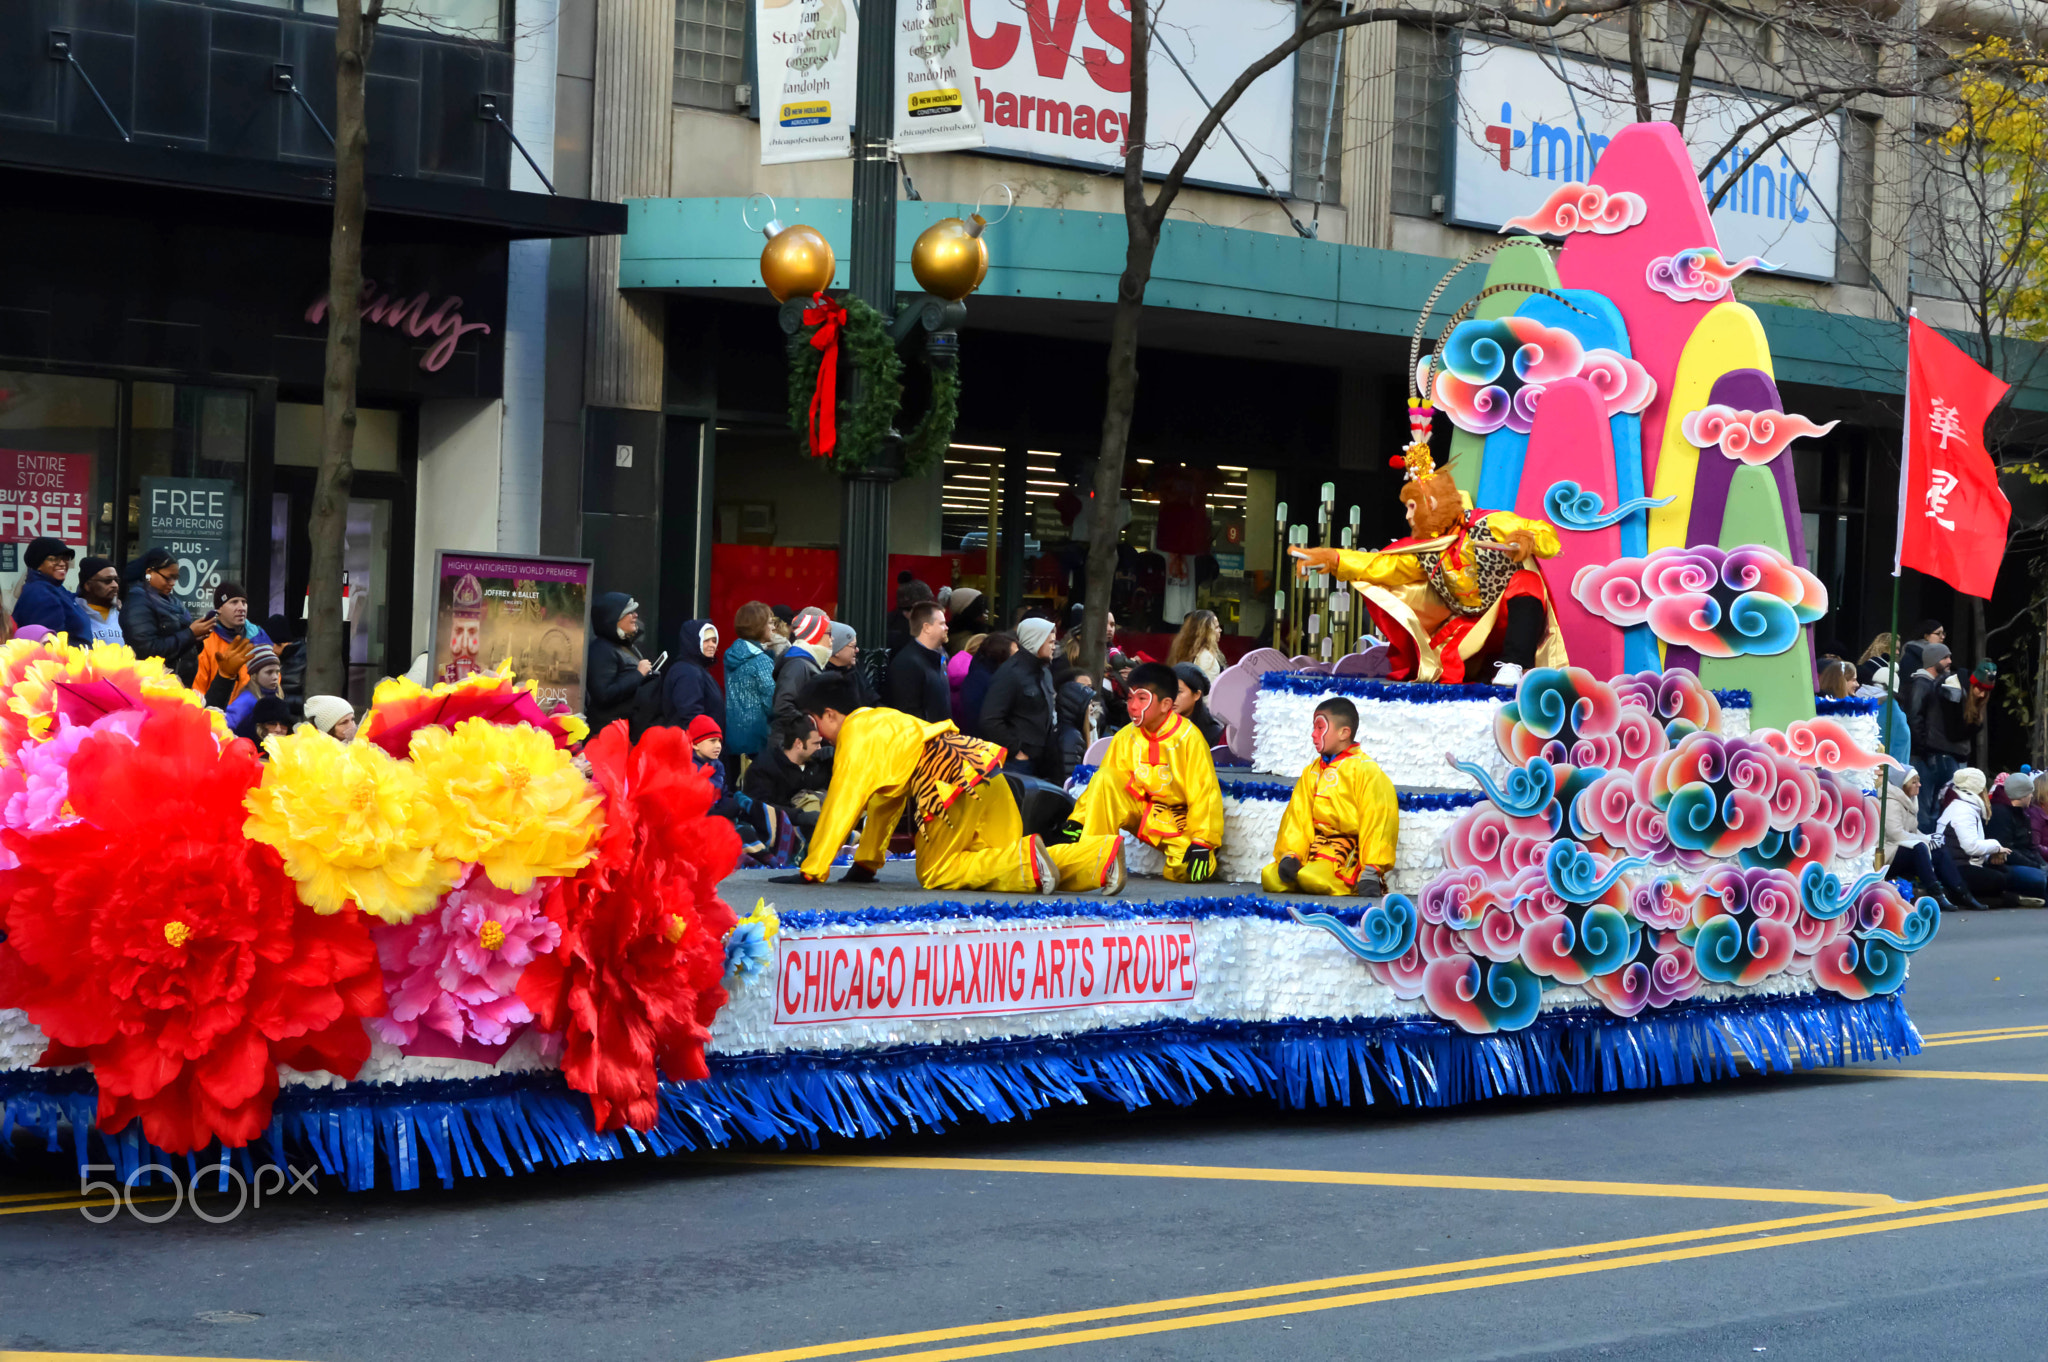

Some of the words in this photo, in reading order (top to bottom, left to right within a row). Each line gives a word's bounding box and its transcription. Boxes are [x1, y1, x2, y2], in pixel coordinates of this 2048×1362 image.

[800, 12, 820, 24] am
[929, 12, 956, 28] Street
[772, 30, 804, 45] Stae
[806, 25, 837, 41] Street
[964, 0, 1132, 93] CVS
[907, 66, 957, 83] Randolph
[784, 77, 831, 95] andolph
[918, 96, 931, 104] NEW
[932, 94, 958, 103] HOLLAND
[791, 108, 803, 116] NEW
[803, 106, 827, 114] HOLLAND
[974, 76, 1130, 157] harmacy
[1707, 146, 1810, 224] clinic
[17, 455, 67, 472] ENTIRE
[17, 472, 65, 488] STORE
[0, 489, 27, 503] BUY
[29, 491, 38, 504] 3
[42, 492, 70, 505] GET
[73, 493, 82, 506] 3
[152, 488, 224, 518] FREE
[0, 503, 83, 539] FREE
[151, 516, 173, 528] EAR
[175, 518, 224, 530] PIERCING
[1230, 527, 1237, 540] 9
[172, 542, 202, 554] PLUS
[171, 557, 221, 596] 0%
[448, 561, 472, 571] HIGHLY
[474, 563, 518, 574] ANTICIPATED
[519, 566, 544, 576] WORLD
[546, 568, 578, 578] PREMIERE
[195, 588, 216, 600] OF
[484, 589, 510, 598] JOFFREY
[518, 591, 540, 599] BALLET
[187, 601, 214, 609] PURCHA
[537, 687, 568, 700] DON'S
[783, 946, 906, 1015] CHICAGO
[911, 940, 1026, 1007] HUAXING
[1030, 936, 1095, 1000] ARTS
[1102, 934, 1194, 994] TROUPE
